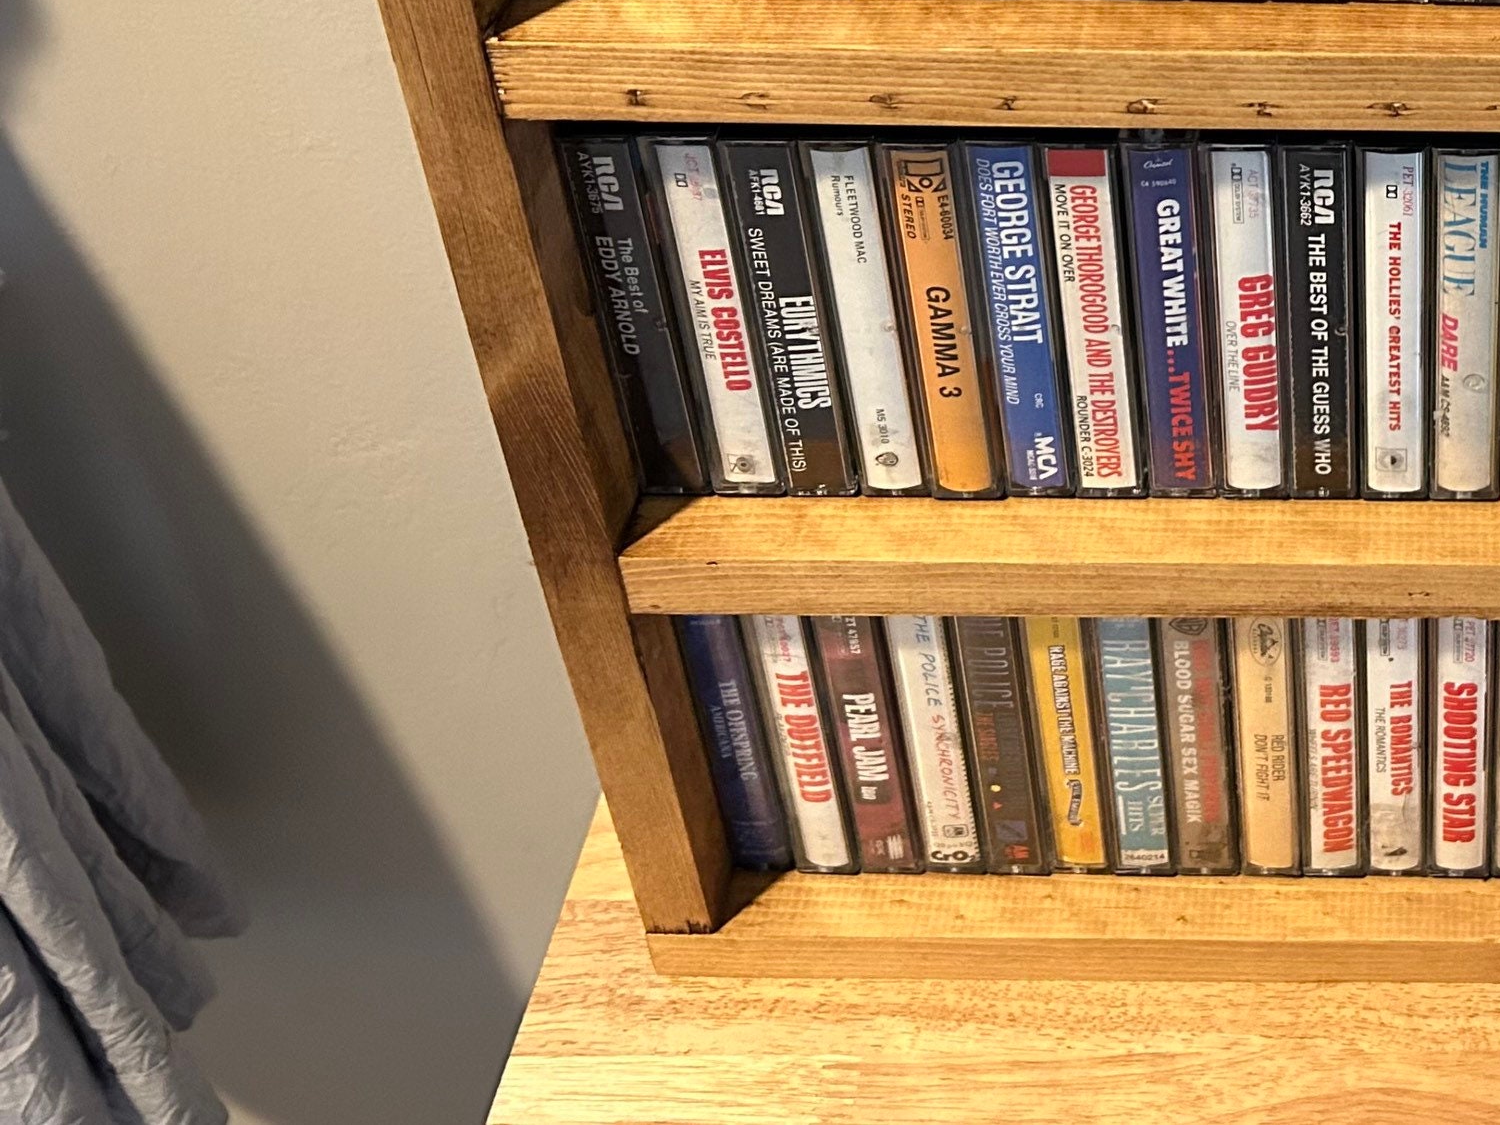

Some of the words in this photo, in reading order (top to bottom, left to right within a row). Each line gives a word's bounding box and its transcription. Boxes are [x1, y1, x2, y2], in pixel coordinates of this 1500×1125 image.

[827, 175, 847, 216] Rumours
[840, 175, 865, 239] FLEETWOOD
[899, 193, 917, 239] STEREO
[987, 160, 1035, 259] GEORGE
[1066, 184, 1102, 242] GEORGE
[1312, 168, 1336, 224] RCA
[852, 240, 868, 263] MAC
[1306, 233, 1326, 266] THE
[1387, 221, 1401, 250] THE
[1440, 160, 1477, 296] LEAGUE
[594, 235, 623, 286] EDDY
[695, 248, 737, 300] ELVIS
[1001, 265, 1044, 344] STRAIT
[1072, 245, 1111, 334] THOROGOOD
[1236, 273, 1276, 338] GREG
[1307, 271, 1327, 314] BEST
[1386, 255, 1402, 320] HOLLIES'
[606, 285, 641, 355] ARNOLD
[921, 285, 963, 378] GAMMA
[1309, 318, 1328, 341] OF
[1440, 312, 1458, 371] DARE
[706, 305, 755, 391] COSTELLO
[773, 294, 836, 409] EURYTHMICS
[1082, 338, 1113, 368] AND
[1310, 345, 1329, 377] THE
[1386, 326, 1402, 398] GREATEST
[938, 386, 963, 398] 3
[1086, 371, 1116, 396] THE
[1238, 344, 1280, 431] GUIDRY
[1311, 381, 1331, 434] GUESS
[1087, 399, 1124, 478] DESTROYERS
[1388, 401, 1400, 431] HITS
[1032, 435, 1060, 480] MCA
[1313, 437, 1331, 475] WHO
[774, 670, 815, 708] THE
[1171, 640, 1192, 689] BLOOD
[841, 692, 882, 741] PEARL
[1175, 693, 1197, 742] SUGAR
[1388, 680, 1412, 709] THE
[782, 713, 834, 803] OUTFIELD
[1270, 734, 1285, 752] RED
[1388, 714, 1413, 796] ROMANTICS
[1442, 681, 1477, 786] SHOOTING
[851, 745, 890, 781] JAM
[1180, 747, 1199, 774] SEX
[1271, 754, 1286, 781] RIDER
[1182, 778, 1202, 823] MAGIK
[1317, 727, 1355, 853] SPEEDWAGON
[1442, 792, 1475, 842] STAR
